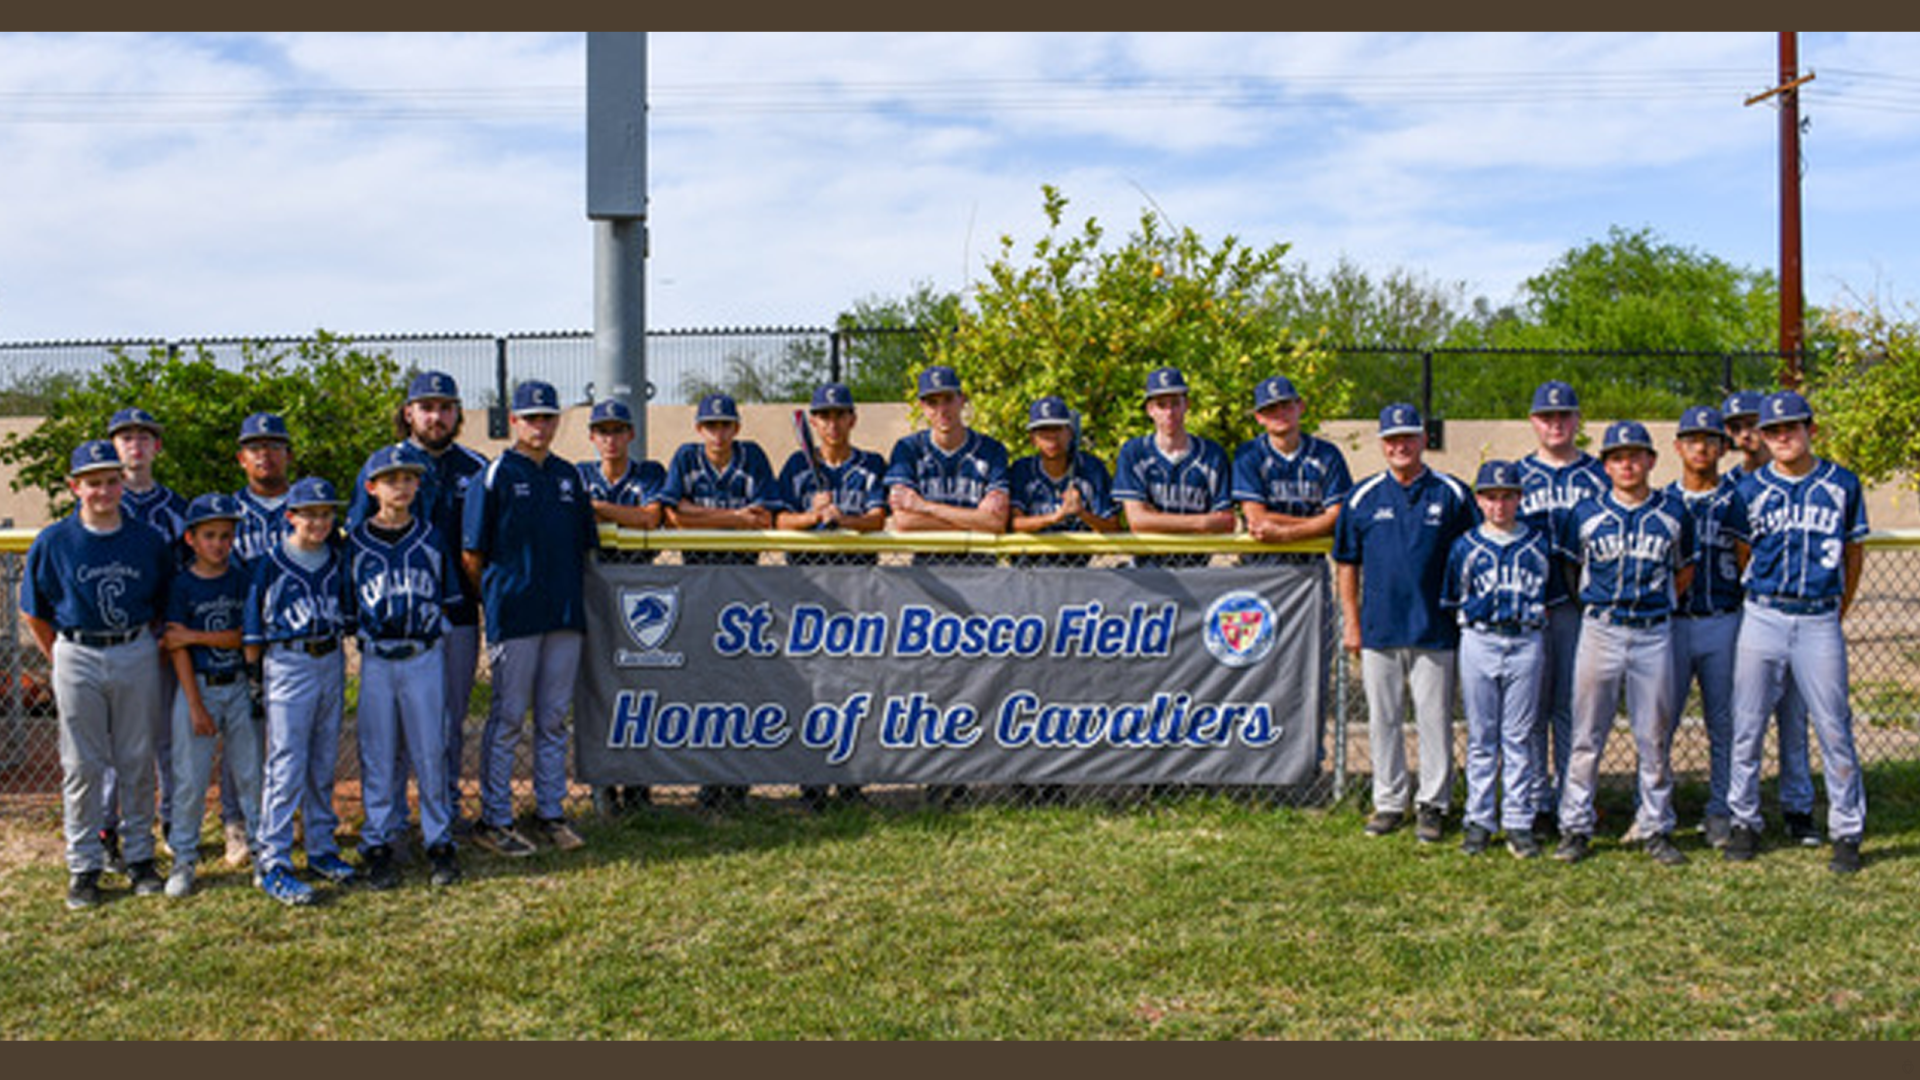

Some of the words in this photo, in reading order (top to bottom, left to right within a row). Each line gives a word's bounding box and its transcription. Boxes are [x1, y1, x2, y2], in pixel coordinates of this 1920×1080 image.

[1820, 538, 1842, 569] 3
[714, 601, 778, 655] St.
[785, 603, 888, 656] Don
[893, 604, 1046, 656] Bosco
[1052, 602, 1178, 657] Field
[607, 690, 793, 748] Home
[802, 692, 872, 765] of
[880, 692, 983, 748] the
[995, 690, 1283, 749] Cavaliers
